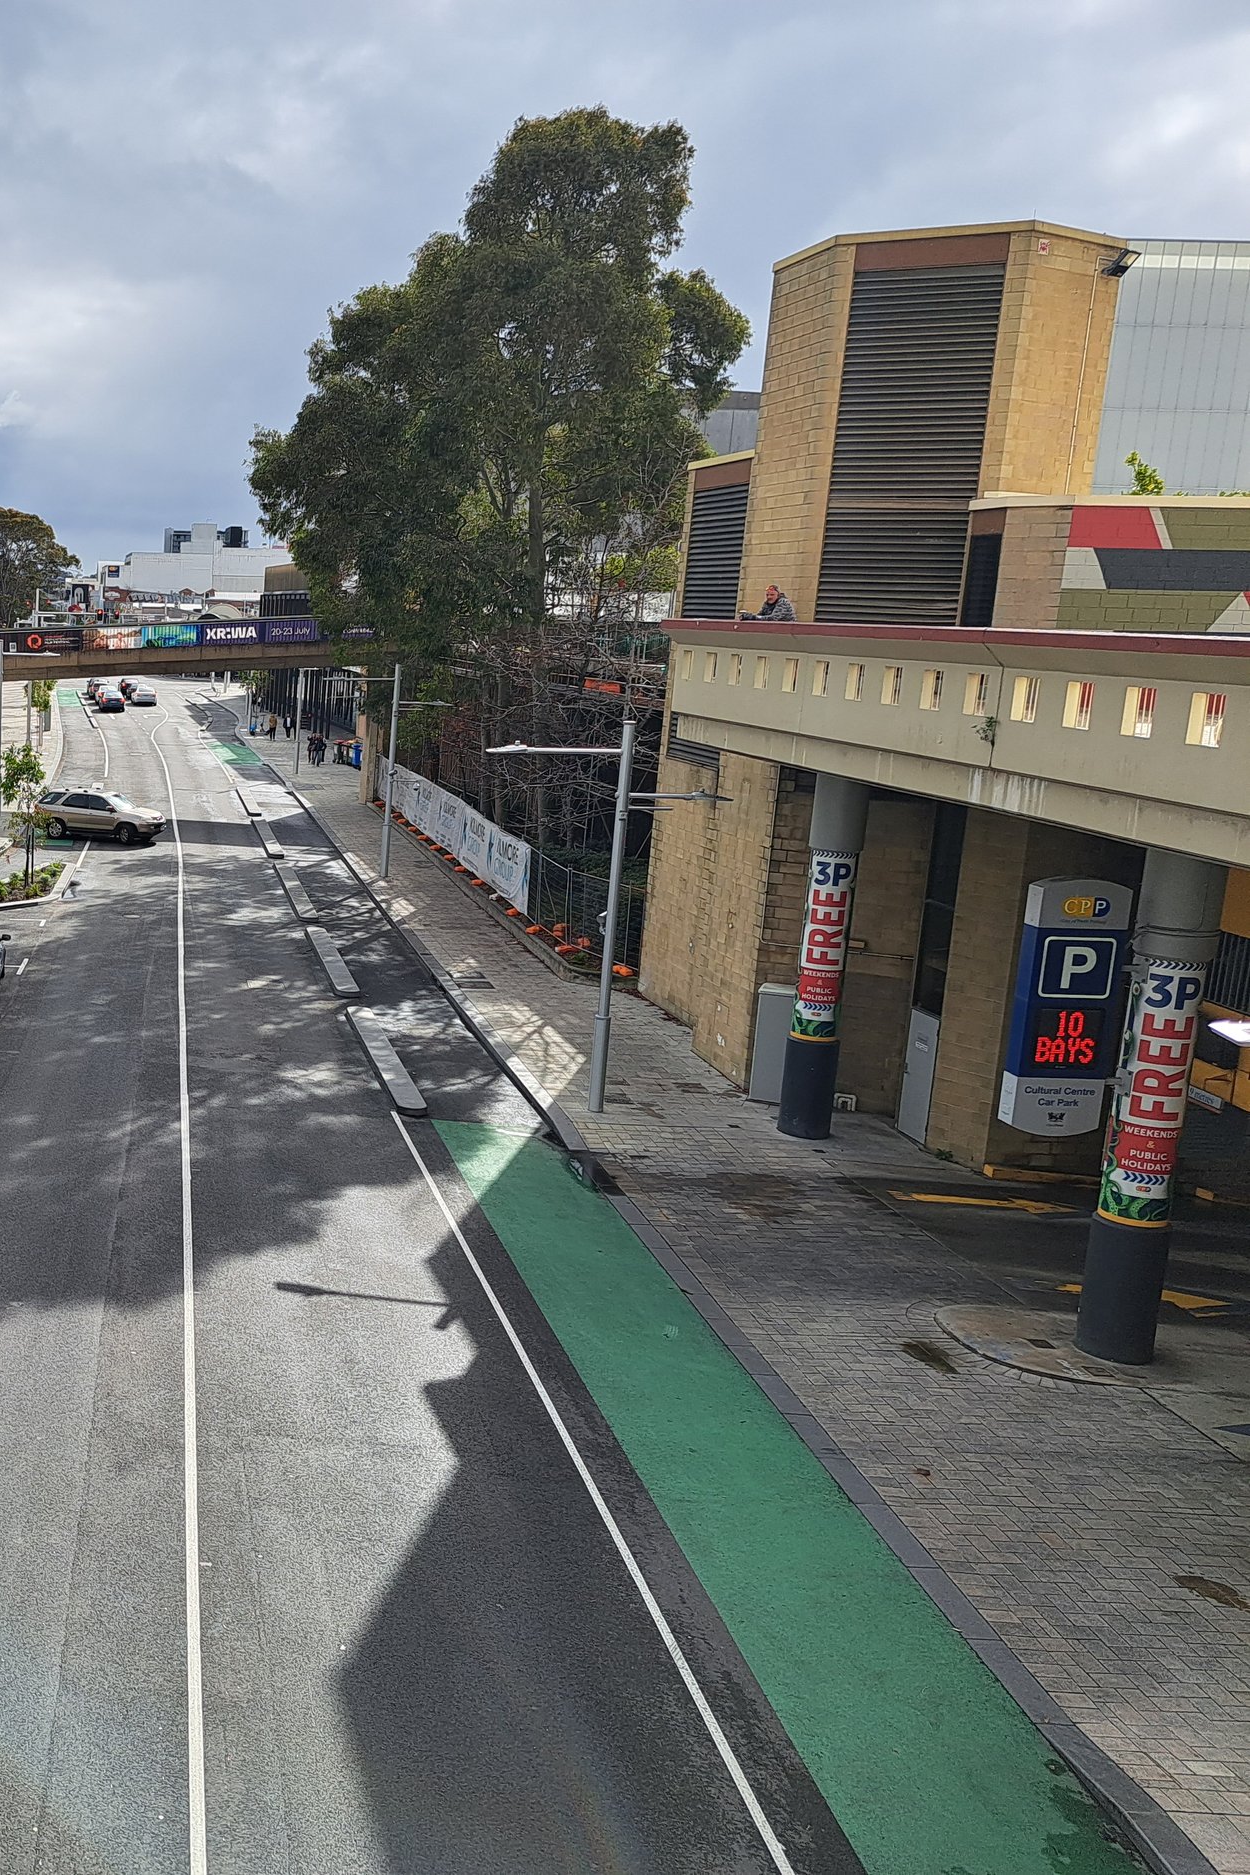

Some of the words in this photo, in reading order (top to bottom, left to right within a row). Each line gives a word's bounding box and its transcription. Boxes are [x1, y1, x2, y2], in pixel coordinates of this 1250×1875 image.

[270, 627, 293, 636] 20-23
[294, 626, 311, 636] July
[813, 860, 851, 887] 3P
[1064, 899, 1107, 914] CPP
[805, 889, 848, 966] FREE
[803, 969, 840, 978] WEEKENDS
[1060, 946, 1097, 989] P
[806, 986, 832, 994] PUBLIC
[1144, 973, 1200, 1011] 3P
[801, 993, 836, 1001] HOLIDAYS
[1056, 1010, 1085, 1038] 10
[1035, 1036, 1095, 1064] BAYS
[1129, 1012, 1195, 1122] FREE
[1024, 1085, 1062, 1096] Cultural
[1063, 1087, 1096, 1096] Centre
[1037, 1098, 1054, 1107] Car
[1056, 1098, 1079, 1107] Park
[1123, 1126, 1178, 1139] WEEKENDS
[1146, 1140, 1156, 1149] &
[1129, 1149, 1168, 1161] PUBLIC
[1120, 1158, 1172, 1171] HOLIDAYS
